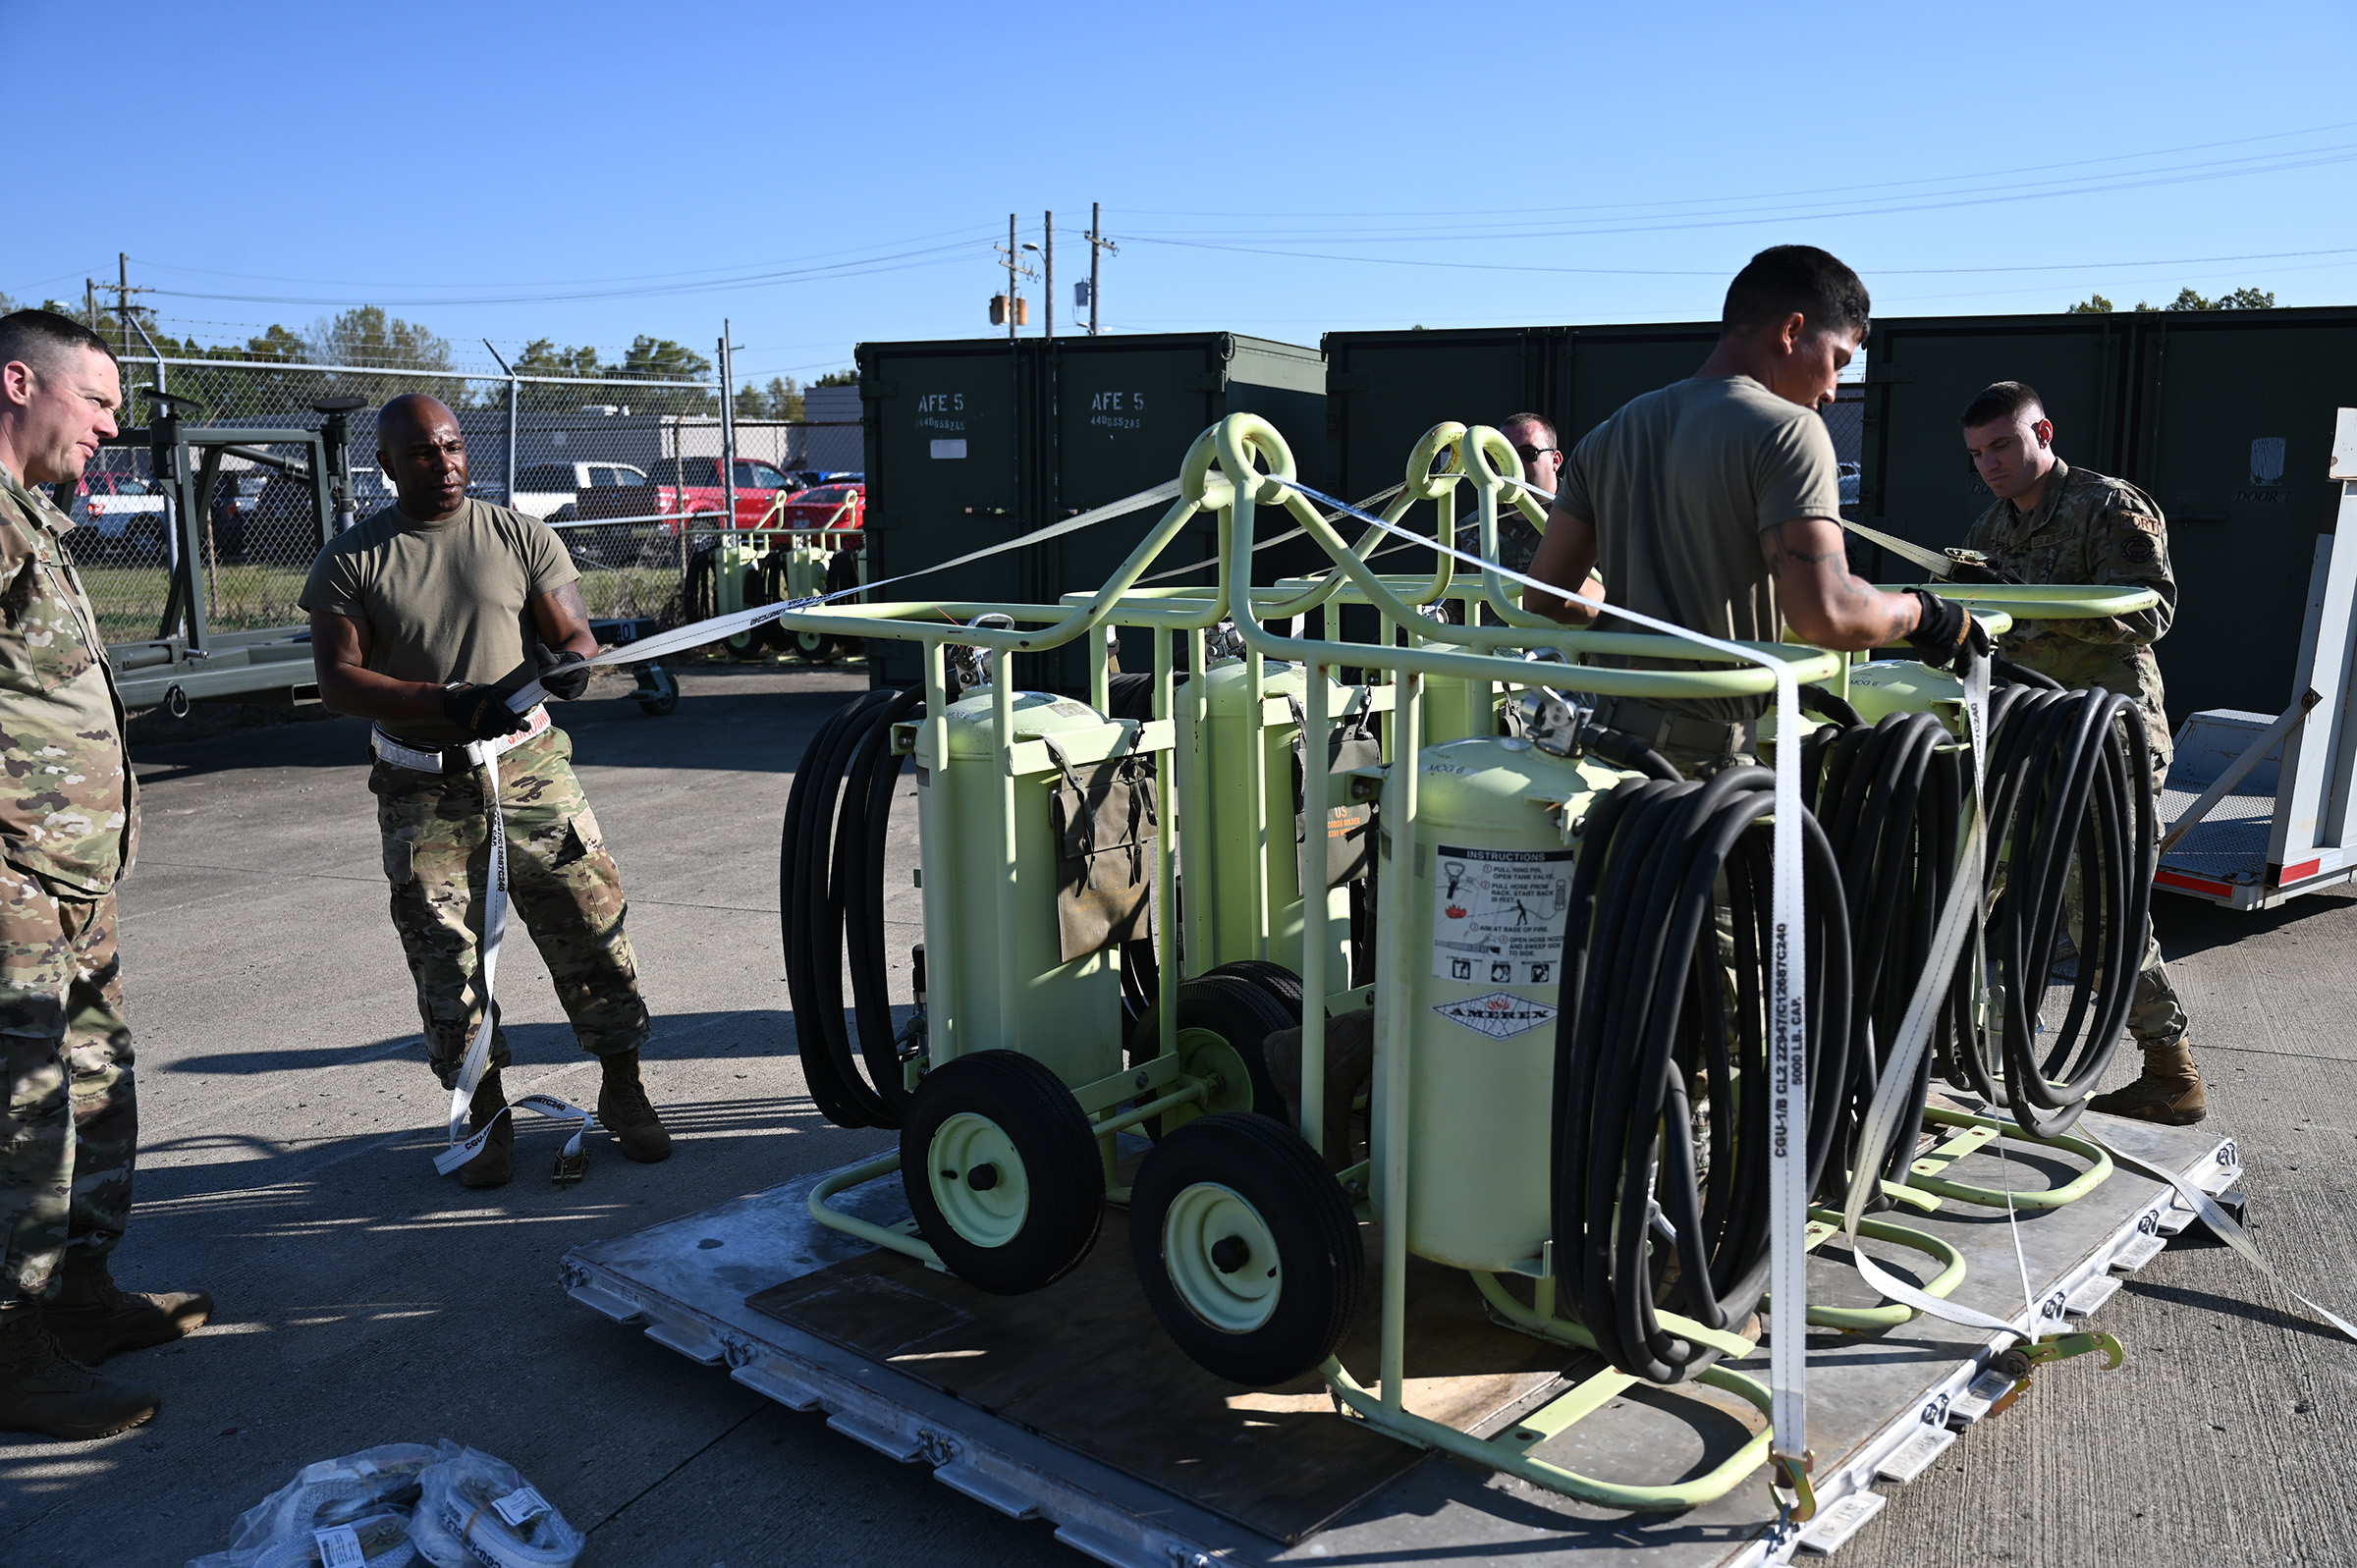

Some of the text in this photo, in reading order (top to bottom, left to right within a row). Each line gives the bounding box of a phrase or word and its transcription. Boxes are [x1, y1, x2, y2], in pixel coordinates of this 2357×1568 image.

[918, 394, 964, 411] AFE 5
[1091, 393, 1144, 410] AFE 5
[2236, 490, 2278, 503] DOOR
[2121, 512, 2160, 533] PORT
[1427, 764, 1453, 773] MOG
[1335, 805, 1347, 819] US
[1466, 850, 1546, 862] INSTRUCTIONS
[1449, 1007, 1549, 1019] AMEREX
[1791, 1029, 1803, 1052] LB.
[1791, 1054, 1803, 1086] 5000
[1775, 1066, 1787, 1095] CL2
[1775, 1098, 1787, 1159] CGU-1/B
